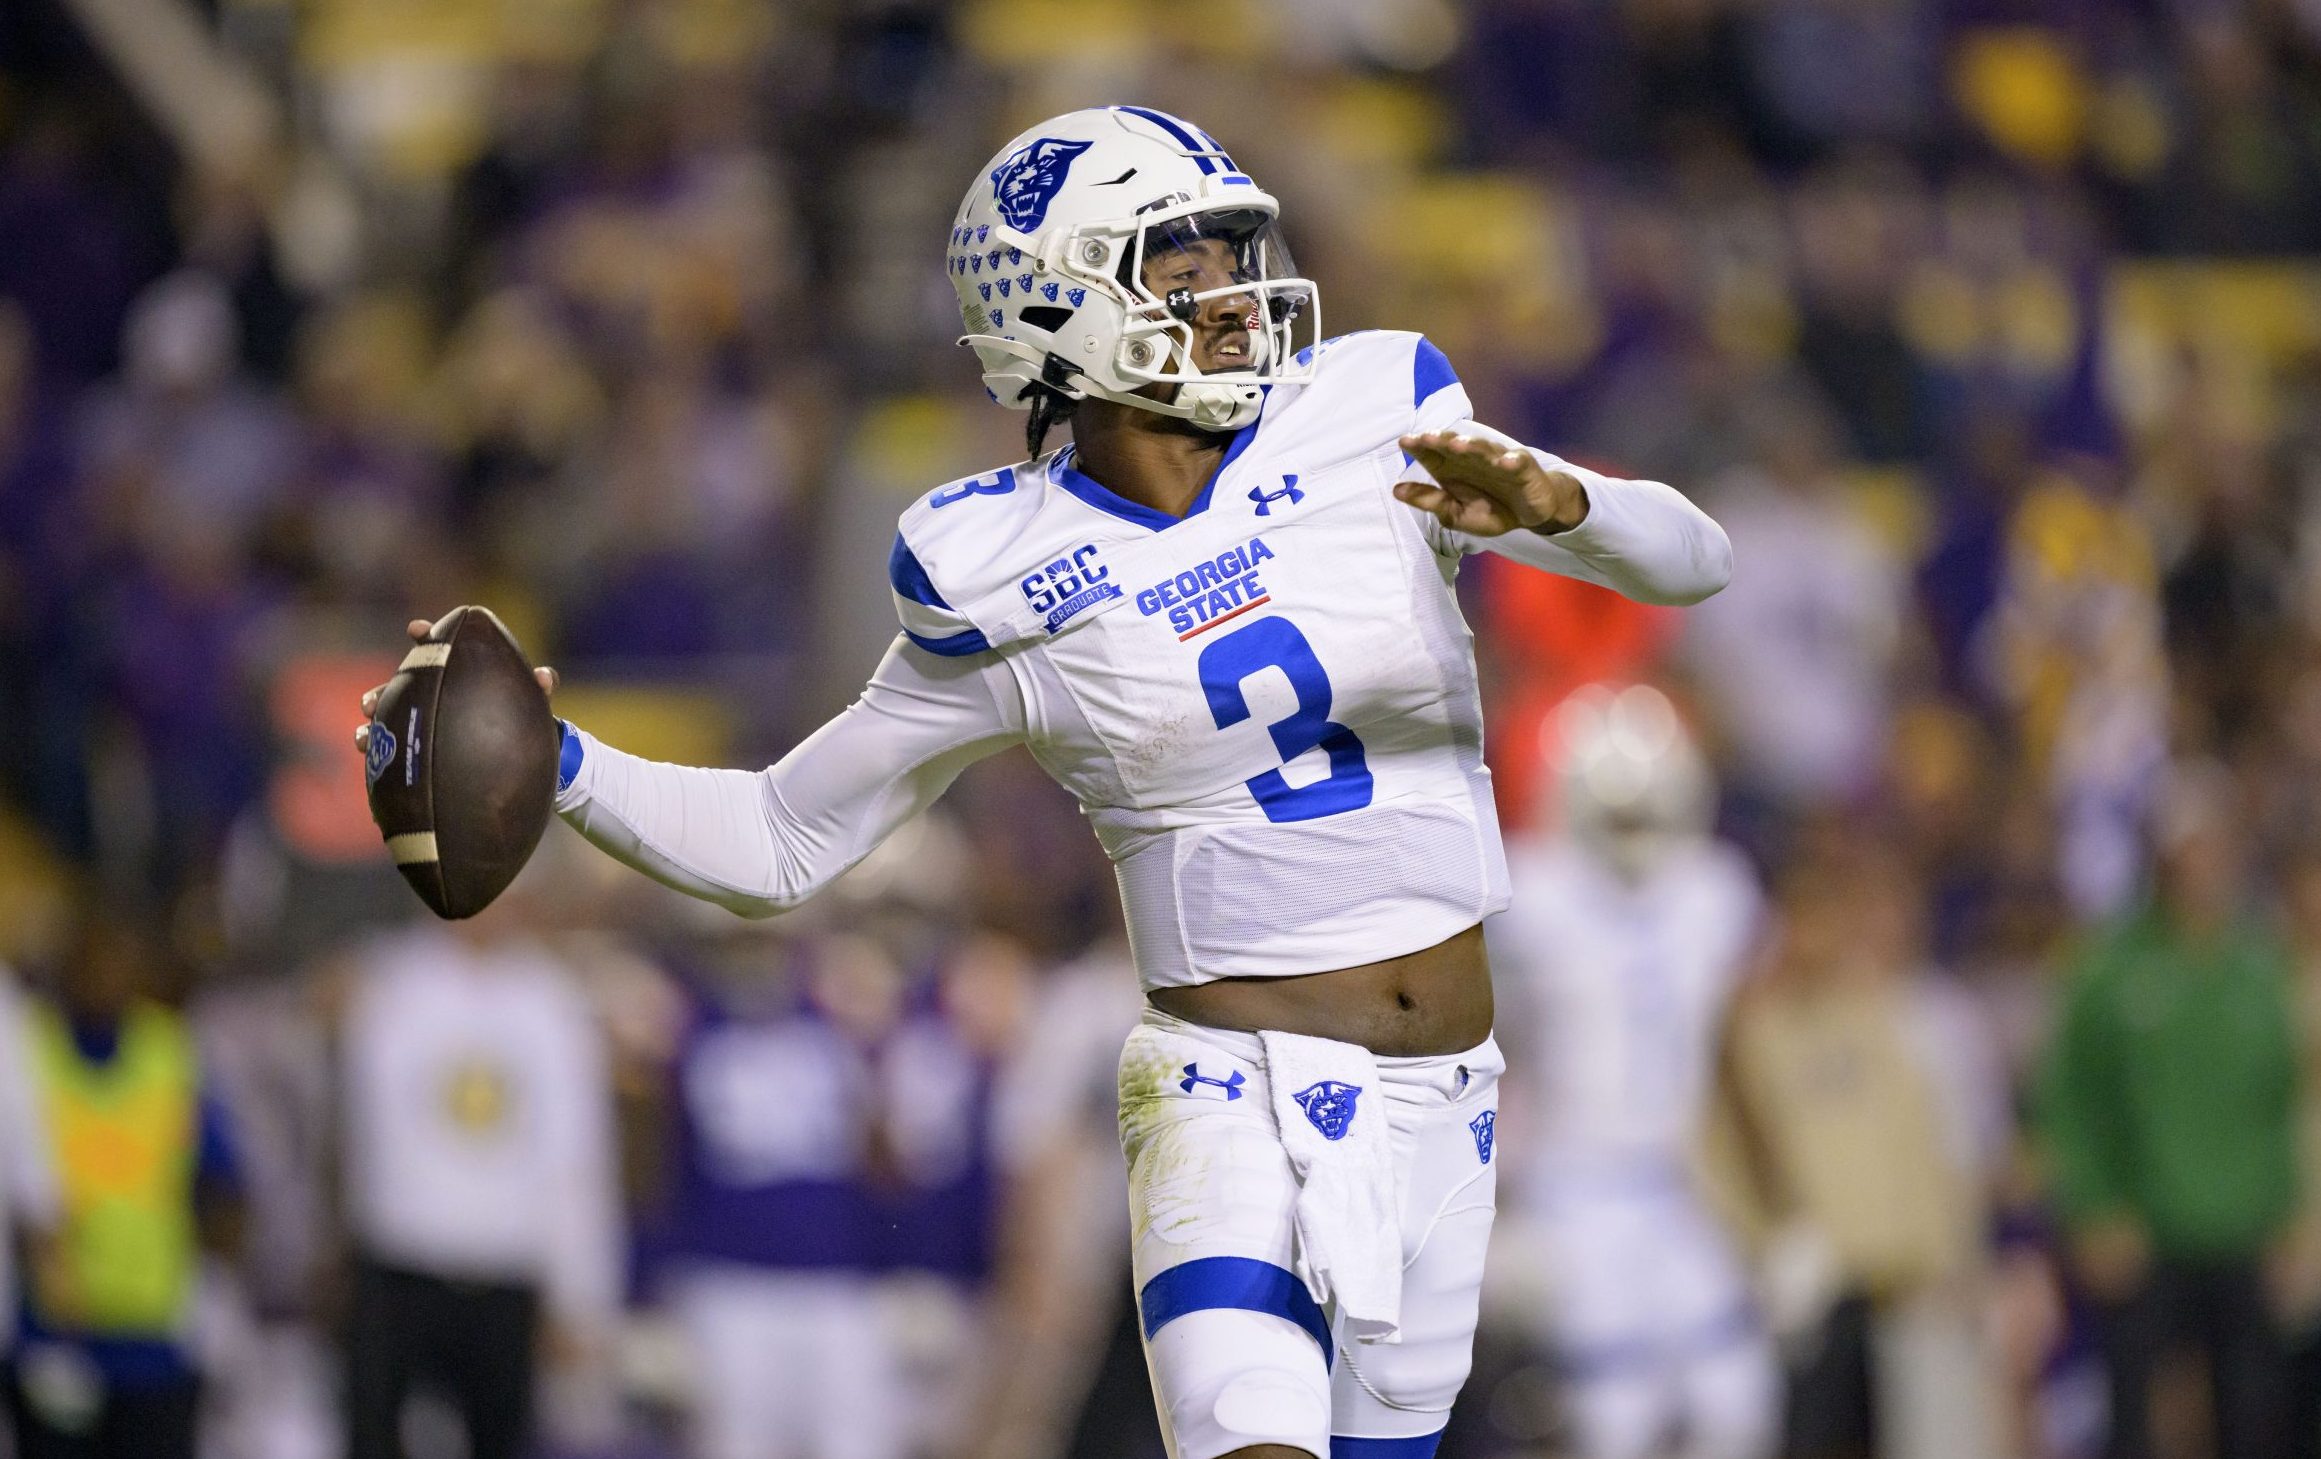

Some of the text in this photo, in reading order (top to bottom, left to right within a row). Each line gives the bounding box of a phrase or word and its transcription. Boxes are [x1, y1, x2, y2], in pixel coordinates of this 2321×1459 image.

[1021, 544, 1109, 614] SBC
[1050, 585, 1111, 625] GRADUATE
[1136, 538, 1275, 617] GEORGIA
[1168, 570, 1267, 634] STATE
[1198, 615, 1374, 823] 3
